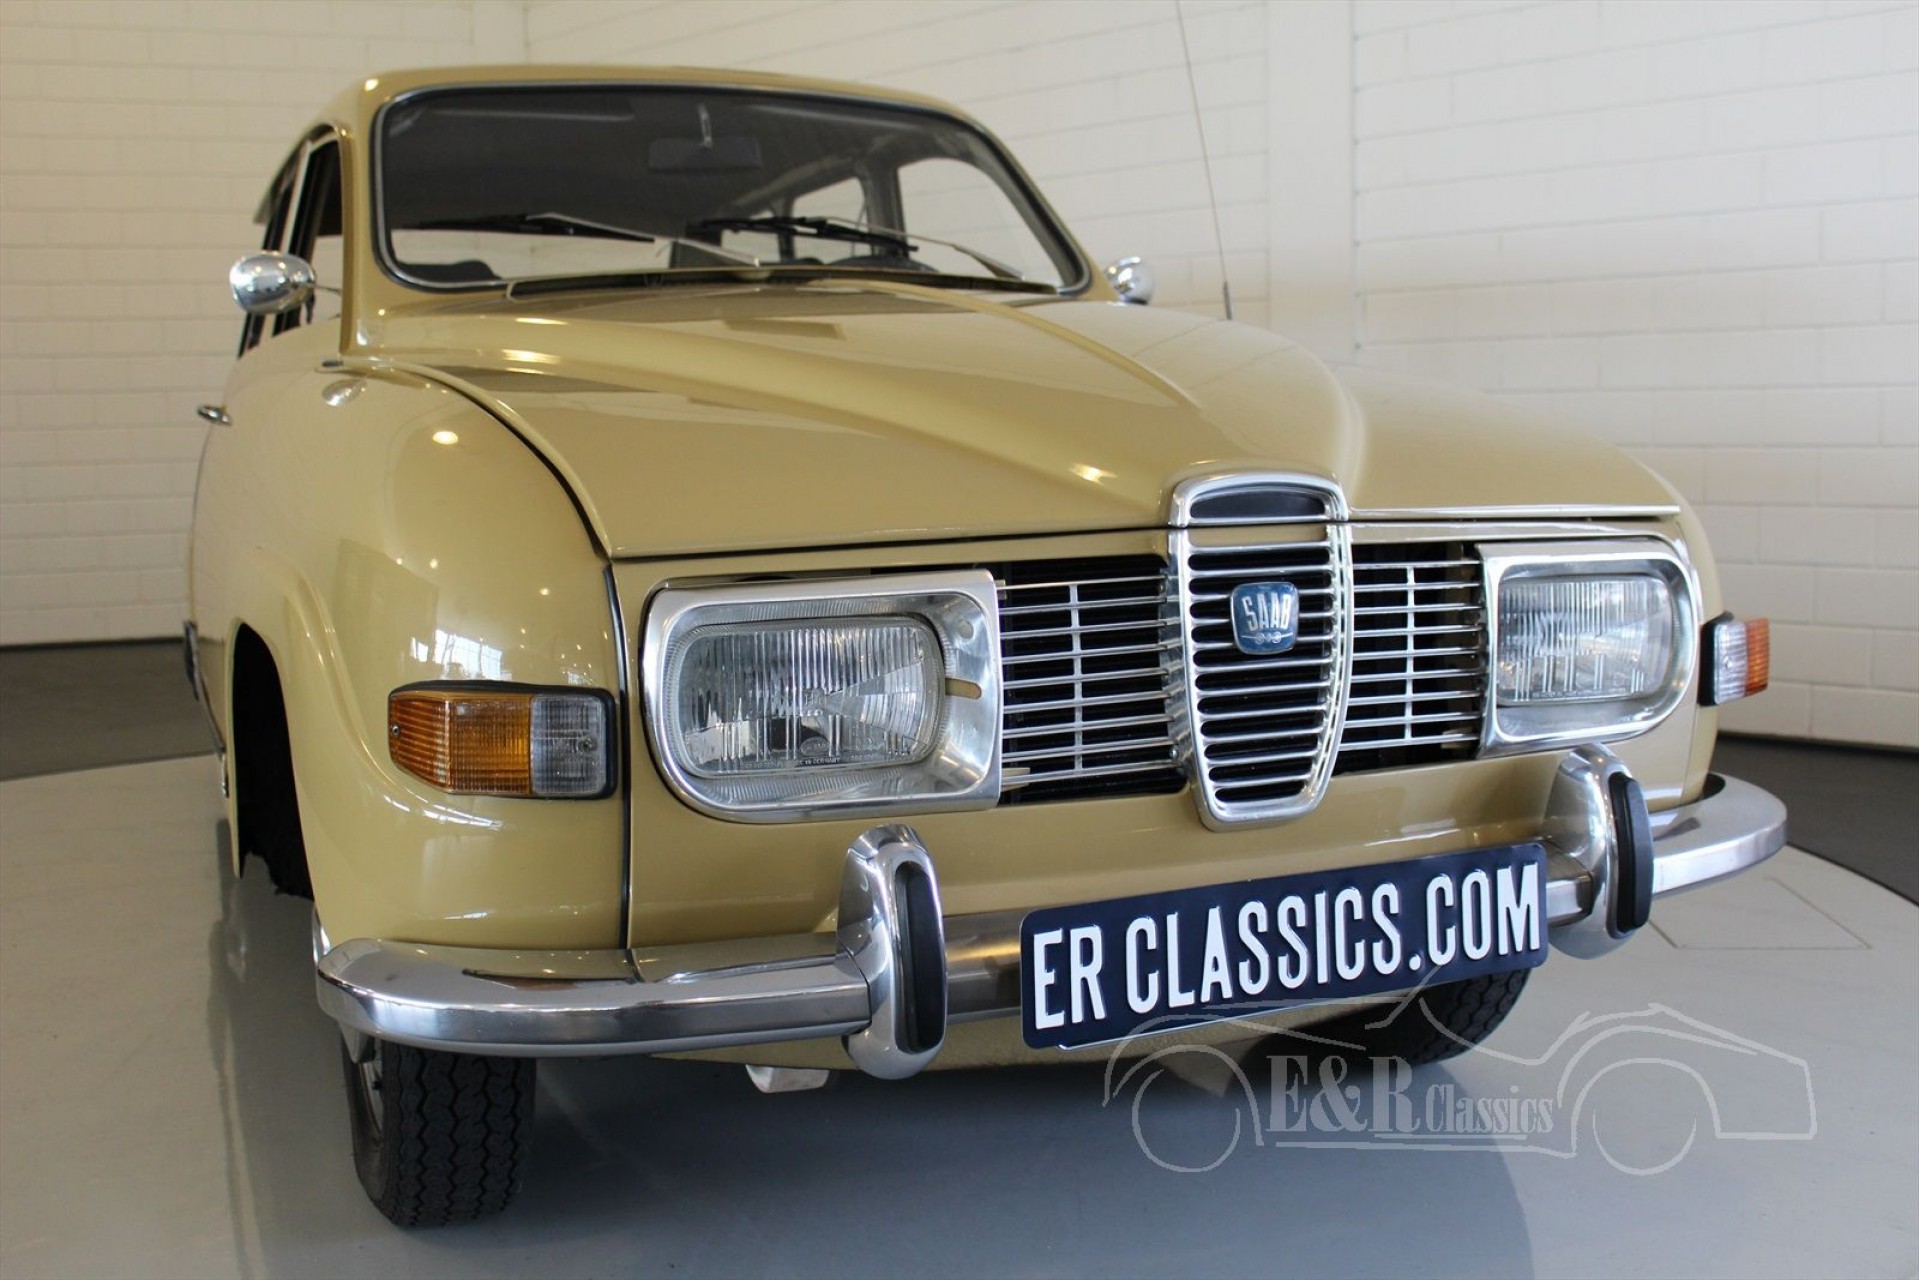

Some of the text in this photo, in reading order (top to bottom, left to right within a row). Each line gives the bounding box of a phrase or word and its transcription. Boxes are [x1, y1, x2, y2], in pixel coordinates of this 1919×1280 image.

[1241, 592, 1292, 631] SAAB
[1033, 861, 1541, 1030] ER CLASSICS.COM
